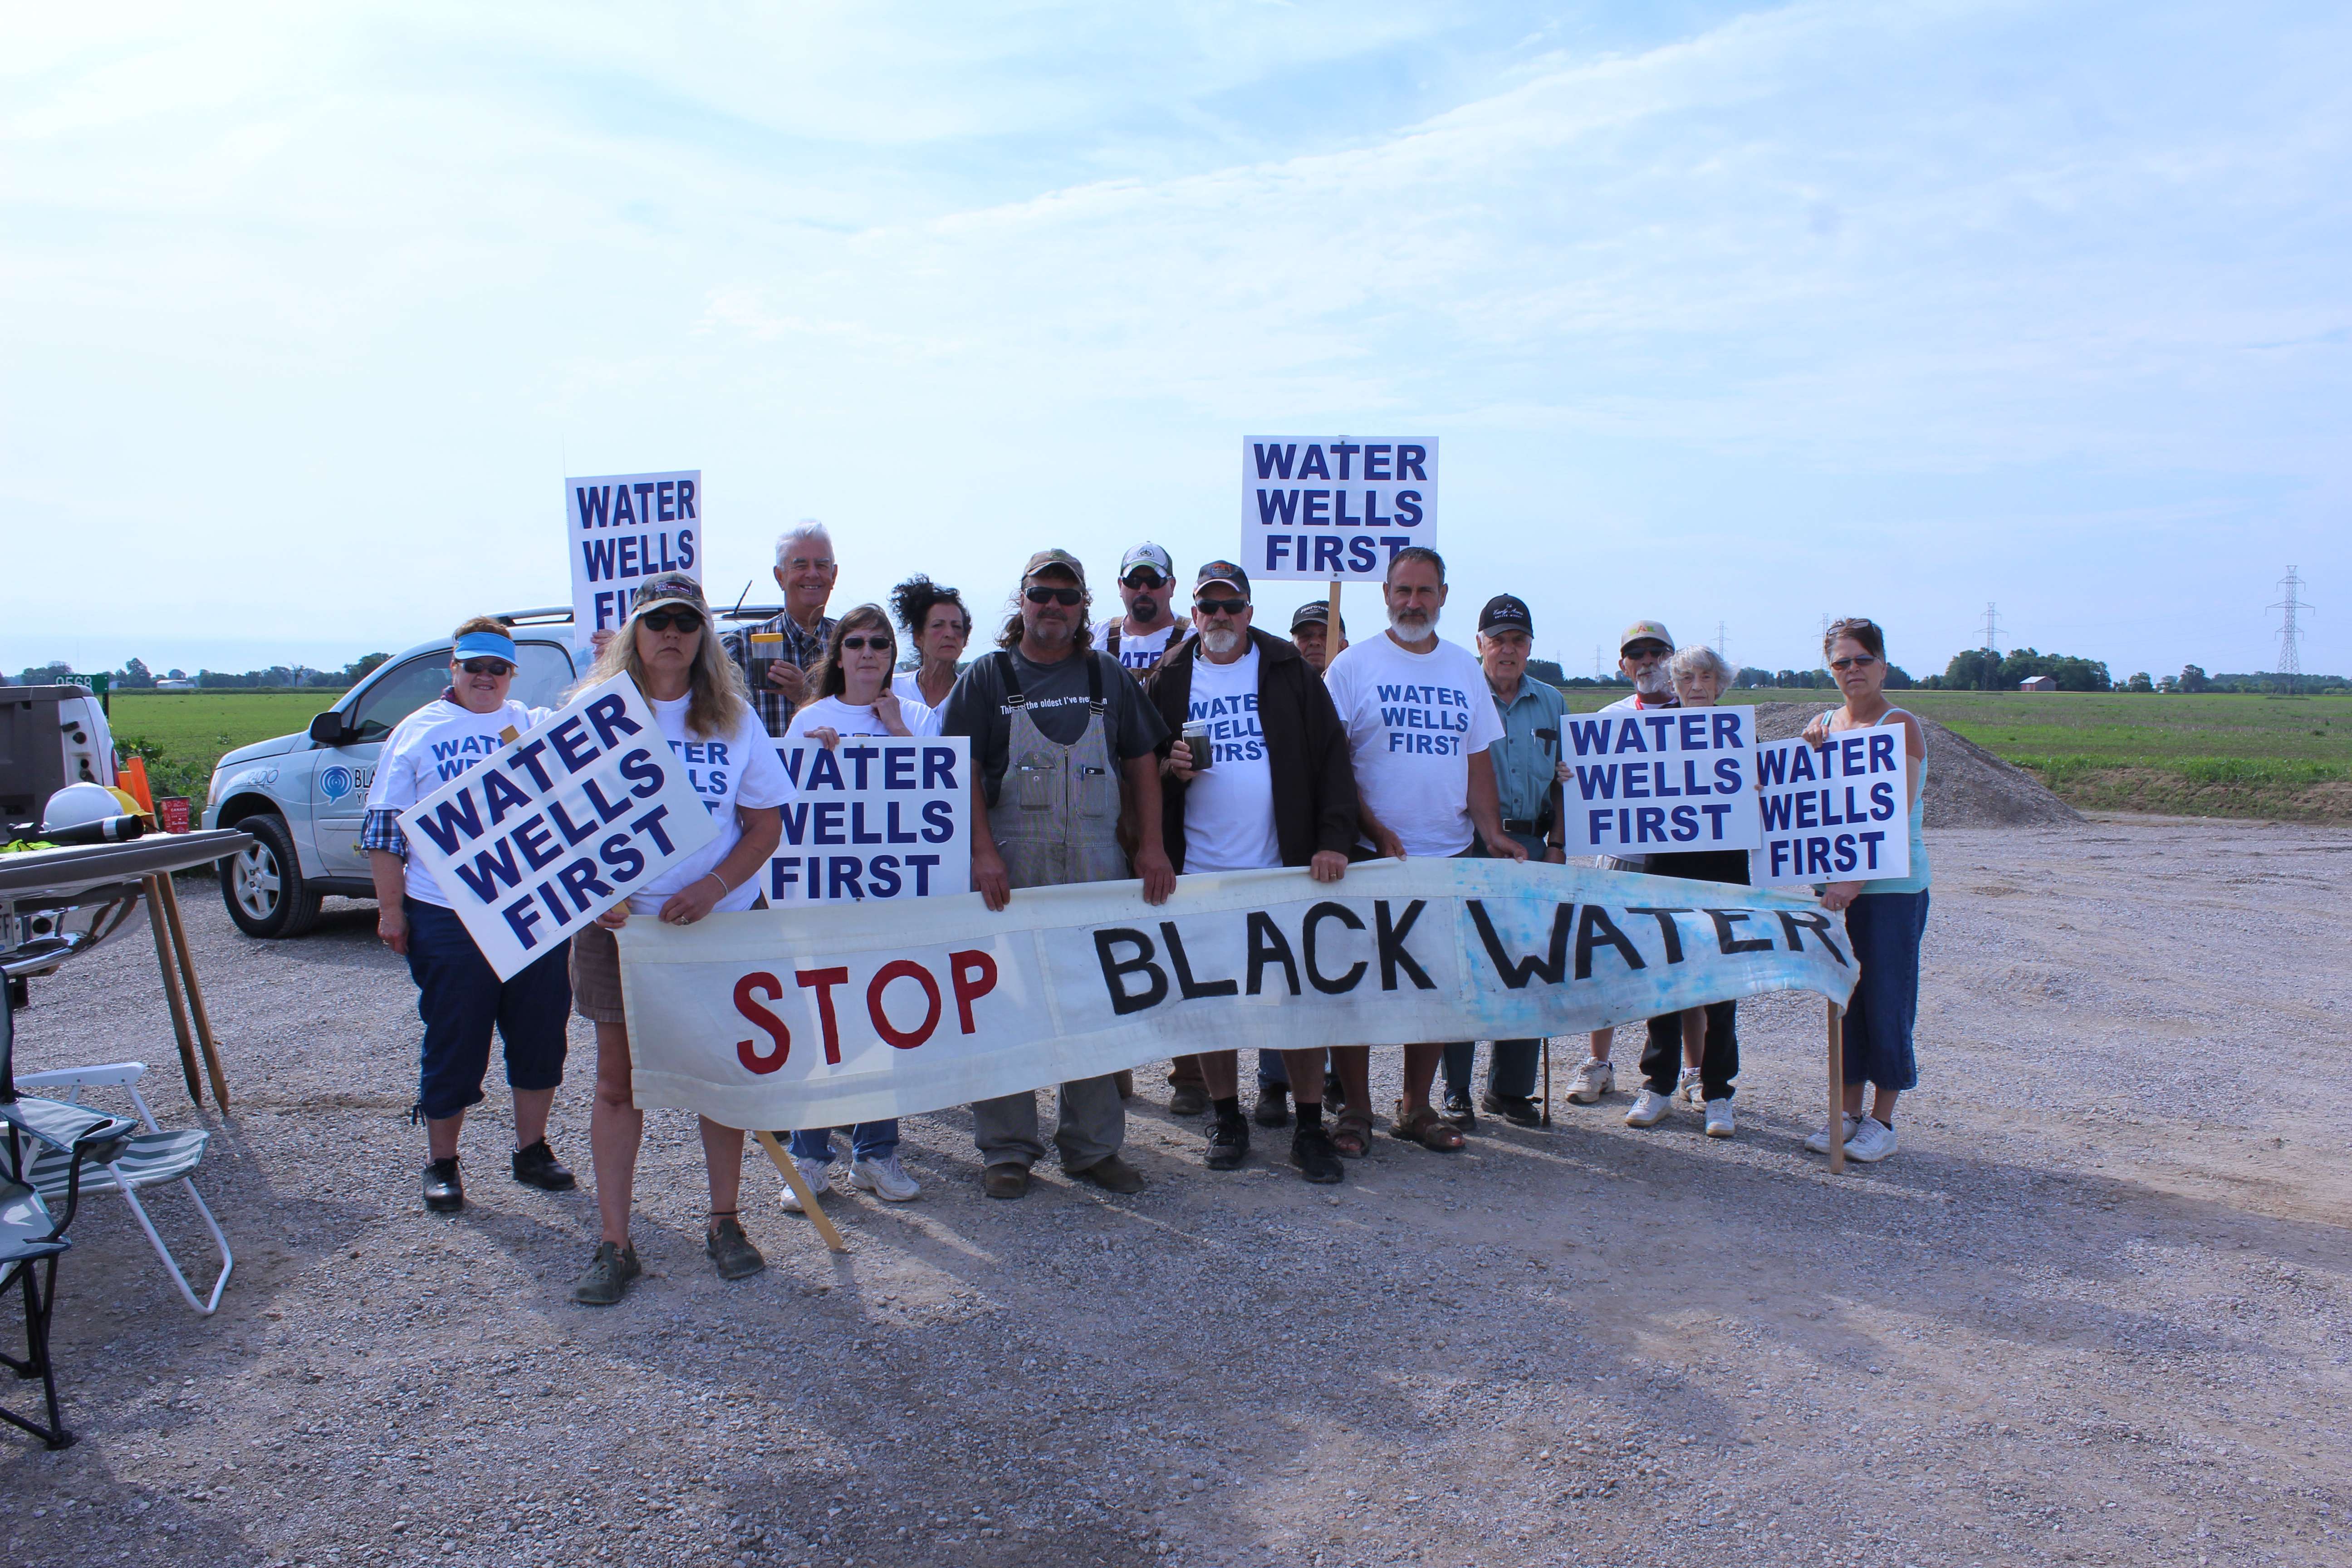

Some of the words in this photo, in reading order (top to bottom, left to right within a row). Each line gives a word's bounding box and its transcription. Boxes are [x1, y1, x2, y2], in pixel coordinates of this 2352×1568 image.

[1254, 444, 1427, 481] WATER
[577, 480, 696, 529] WATER
[1256, 489, 1423, 527] WELLS
[583, 529, 694, 582] WELLS
[1266, 535, 1410, 573] FIRST
[1118, 651, 1164, 668] ATE
[1026, 701, 1039, 710] the
[1040, 699, 1063, 707] oldest
[1063, 696, 1078, 705] I've
[1189, 693, 1258, 721] WATE
[1377, 685, 1468, 709] WATER
[1206, 717, 1263, 740] ELL
[1381, 707, 1468, 732] WELLS
[1569, 713, 1744, 756] WATER
[431, 735, 505, 761] WAT
[1212, 740, 1268, 762] IRS
[1389, 733, 1460, 756] FIRST
[1757, 734, 1896, 787] WATER
[416, 694, 643, 856] WATER
[1575, 758, 1742, 800] WELLS
[455, 749, 664, 904] WELLS
[1589, 804, 1731, 845] FIRST
[1759, 782, 1894, 832] WELLS
[1770, 831, 1884, 877] FIRST
[502, 804, 676, 951] FIRST
[772, 854, 940, 900] FIRST
[733, 949, 998, 1075] STOP
[1093, 899, 1437, 1015] BLACK
[1466, 899, 1849, 989] WATER
